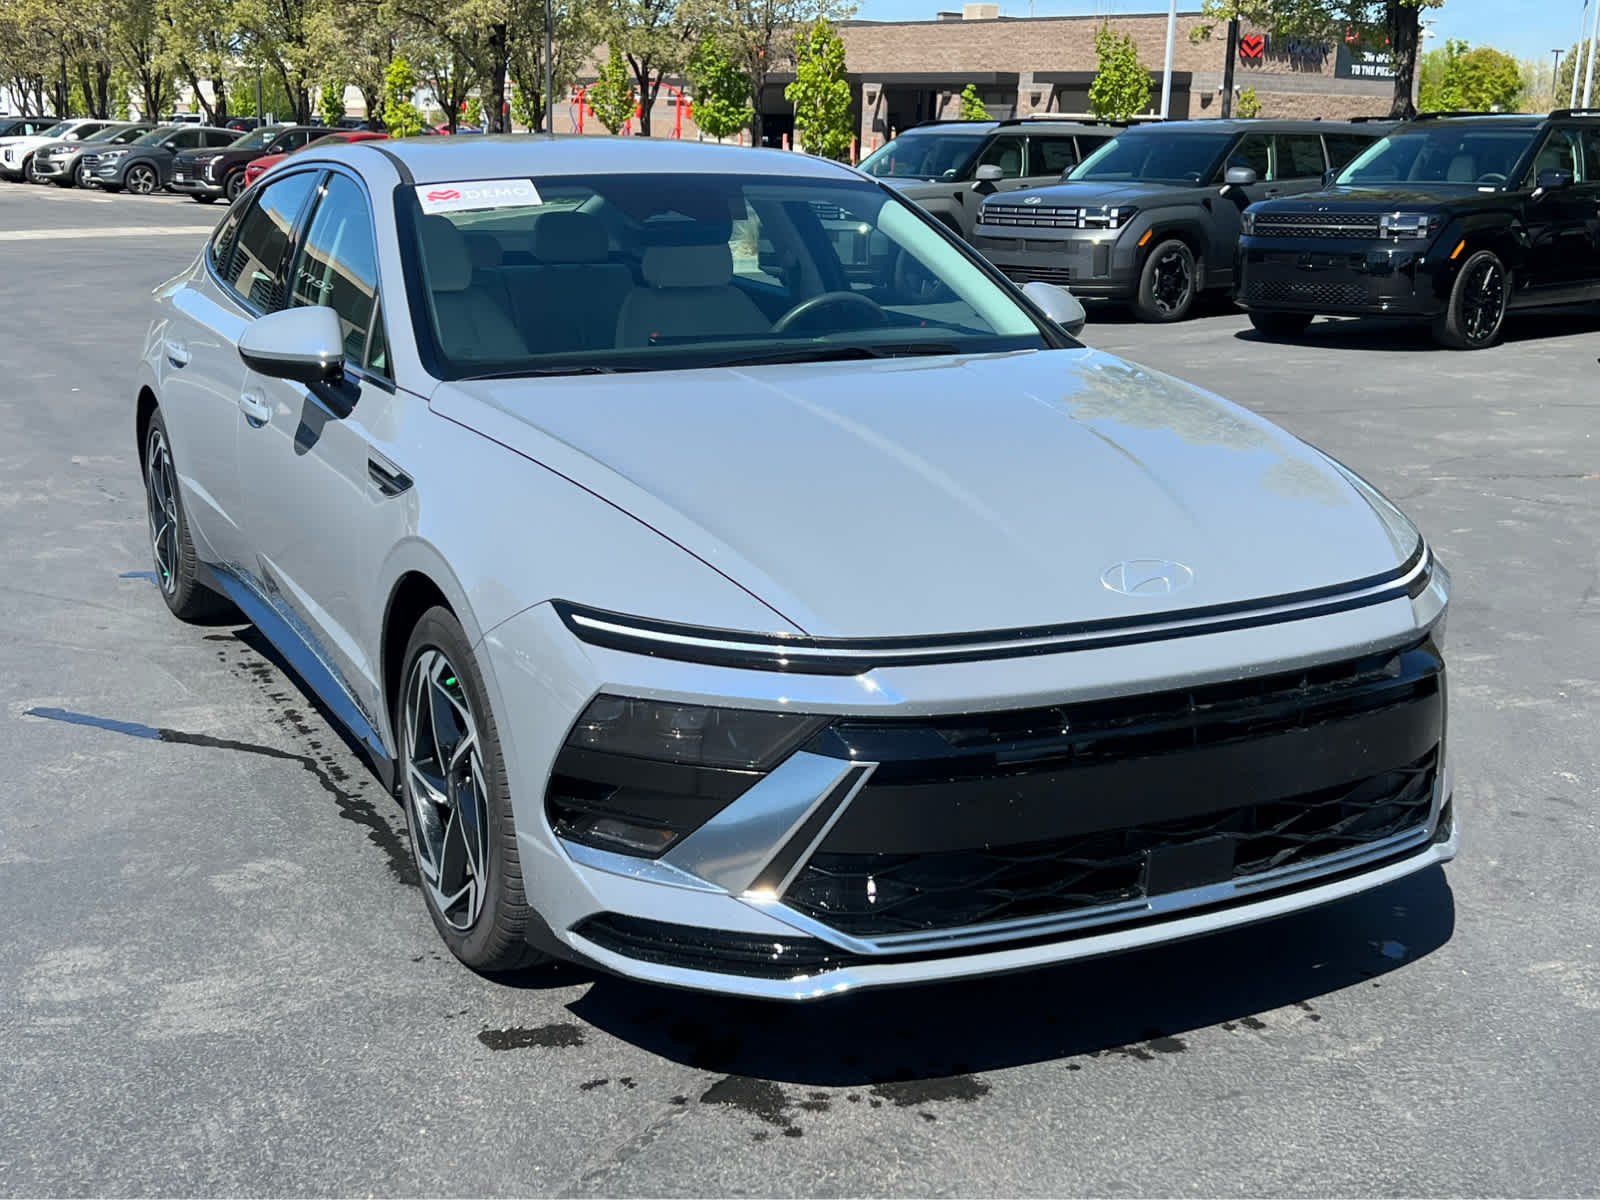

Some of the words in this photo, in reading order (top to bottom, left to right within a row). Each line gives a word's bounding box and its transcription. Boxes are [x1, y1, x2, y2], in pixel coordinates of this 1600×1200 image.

[1351, 64, 1360, 75] TO
[1361, 65, 1375, 76] THE
[462, 186, 530, 201] DEMO
